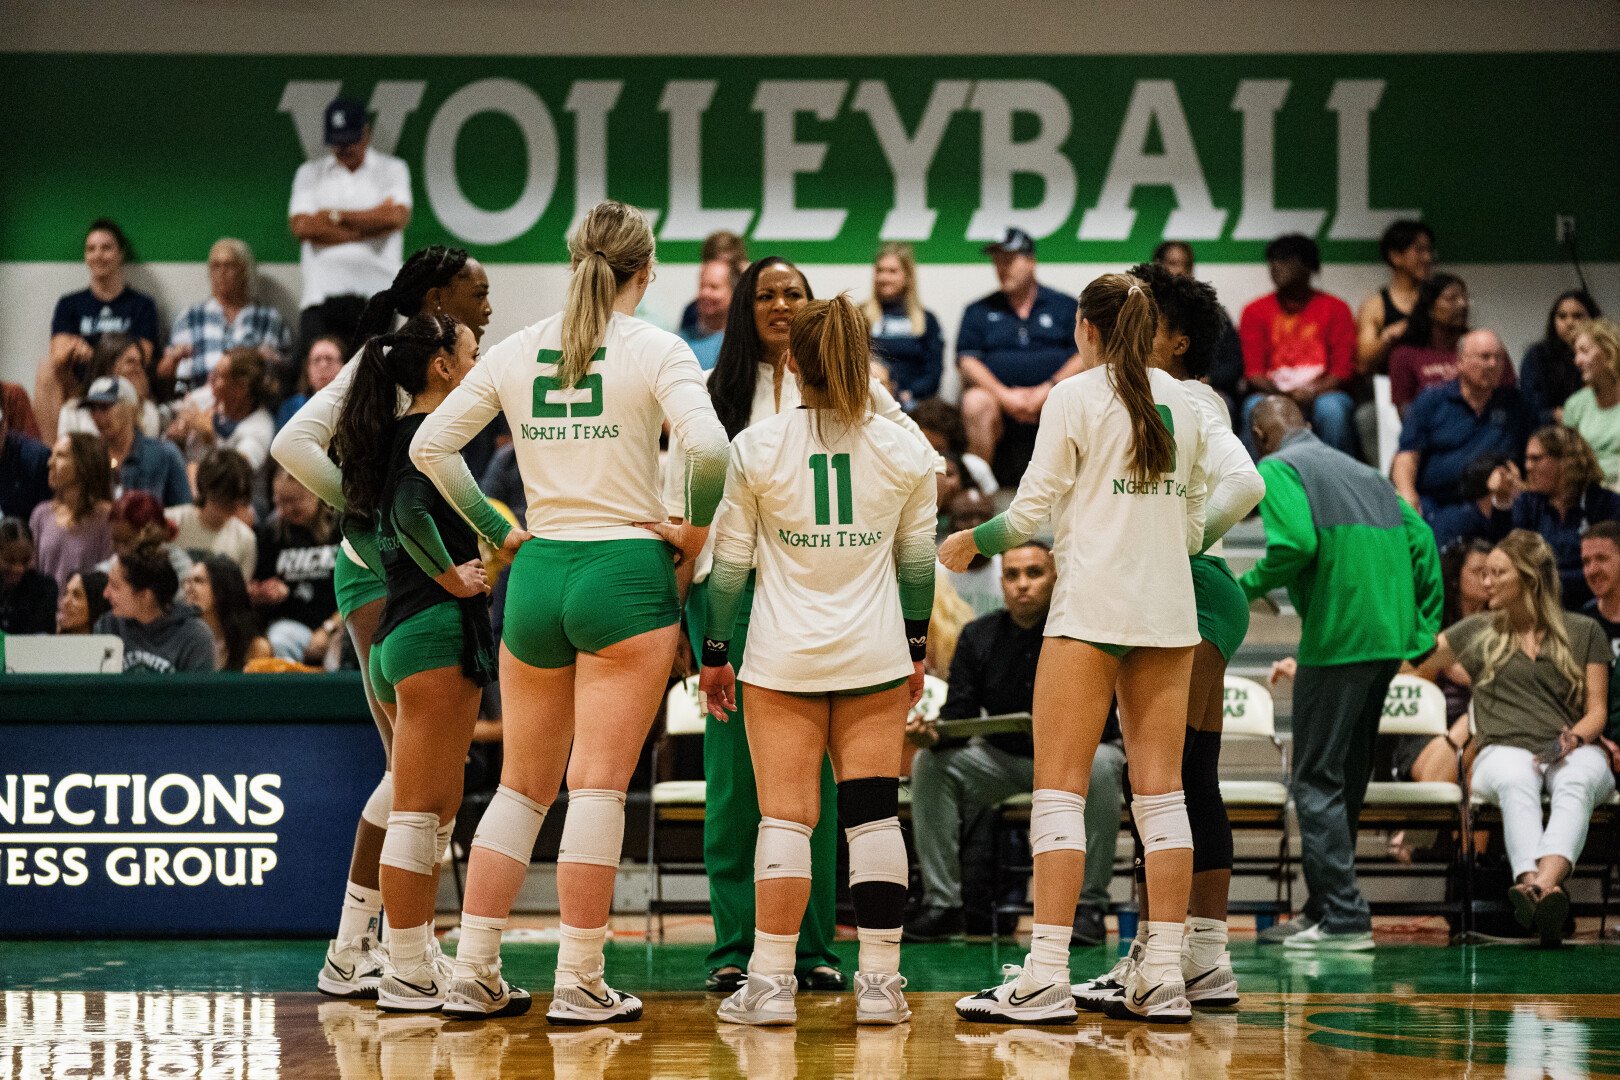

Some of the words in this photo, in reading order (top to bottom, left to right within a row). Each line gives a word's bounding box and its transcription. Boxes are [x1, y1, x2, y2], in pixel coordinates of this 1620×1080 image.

[277, 78, 1422, 243] VOLLEYBALL
[532, 346, 606, 418] 25
[521, 424, 567, 440] NORTH
[572, 424, 619, 439] TEXAS
[809, 453, 853, 525] 11
[779, 528, 831, 547] NORTH
[0, 847, 89, 886] ESS
[105, 847, 278, 886] GROUP
